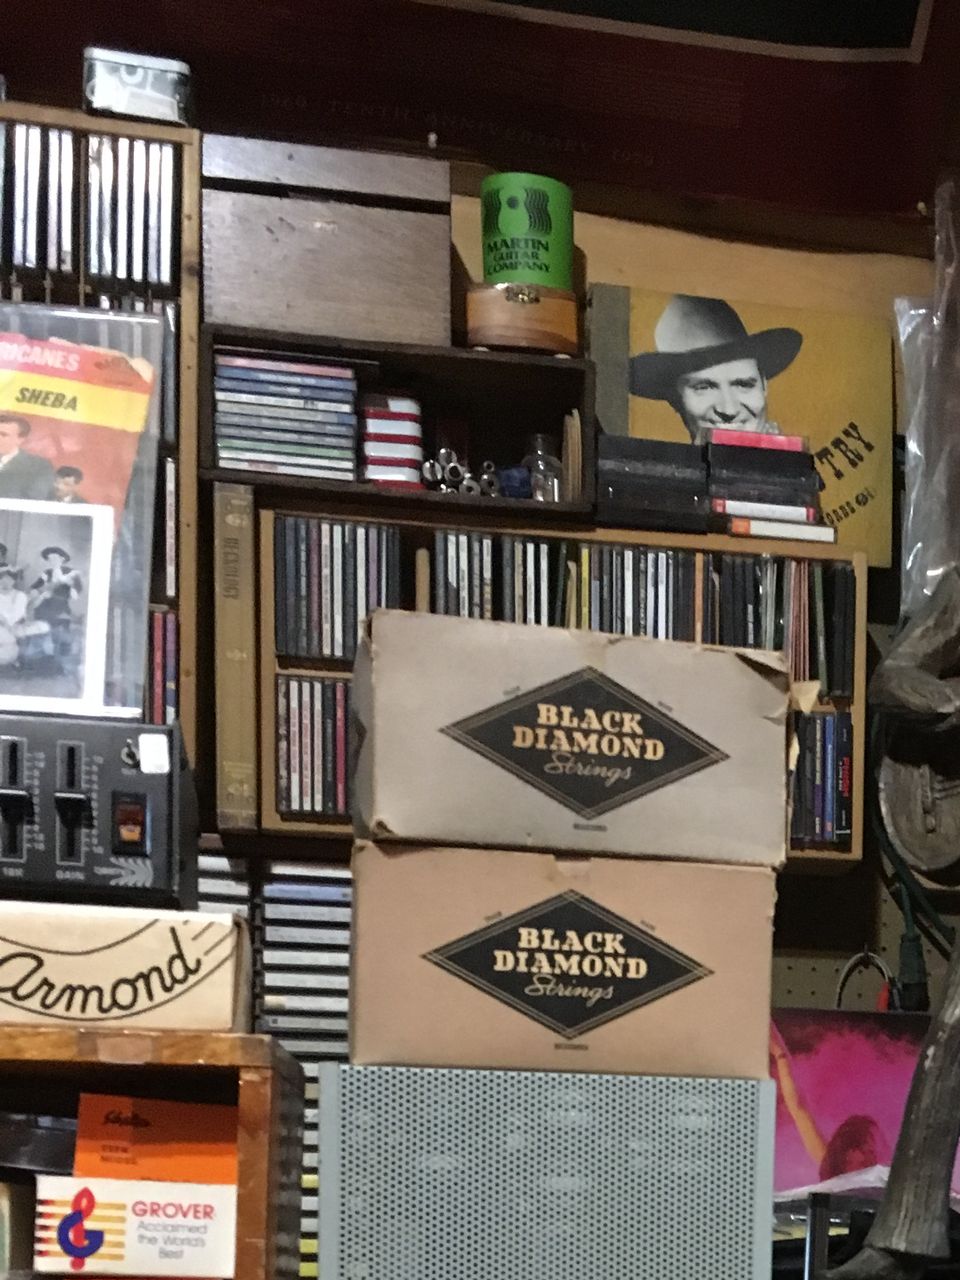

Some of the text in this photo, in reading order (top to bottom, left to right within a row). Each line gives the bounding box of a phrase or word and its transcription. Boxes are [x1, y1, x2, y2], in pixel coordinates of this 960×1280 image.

[486, 237, 550, 253] MARTIN
[486, 261, 551, 276] COMPANY
[15, 386, 78, 412] SHEBA
[537, 703, 643, 736] BLACK
[512, 725, 665, 761] DIAMOND
[543, 750, 632, 788] Strings
[517, 927, 627, 954] BLACK
[493, 949, 648, 980] DIAMOND
[523, 974, 614, 1008] Strings
[131, 1200, 215, 1220] GROVER
[137, 1220, 208, 1234] Acclaimed
